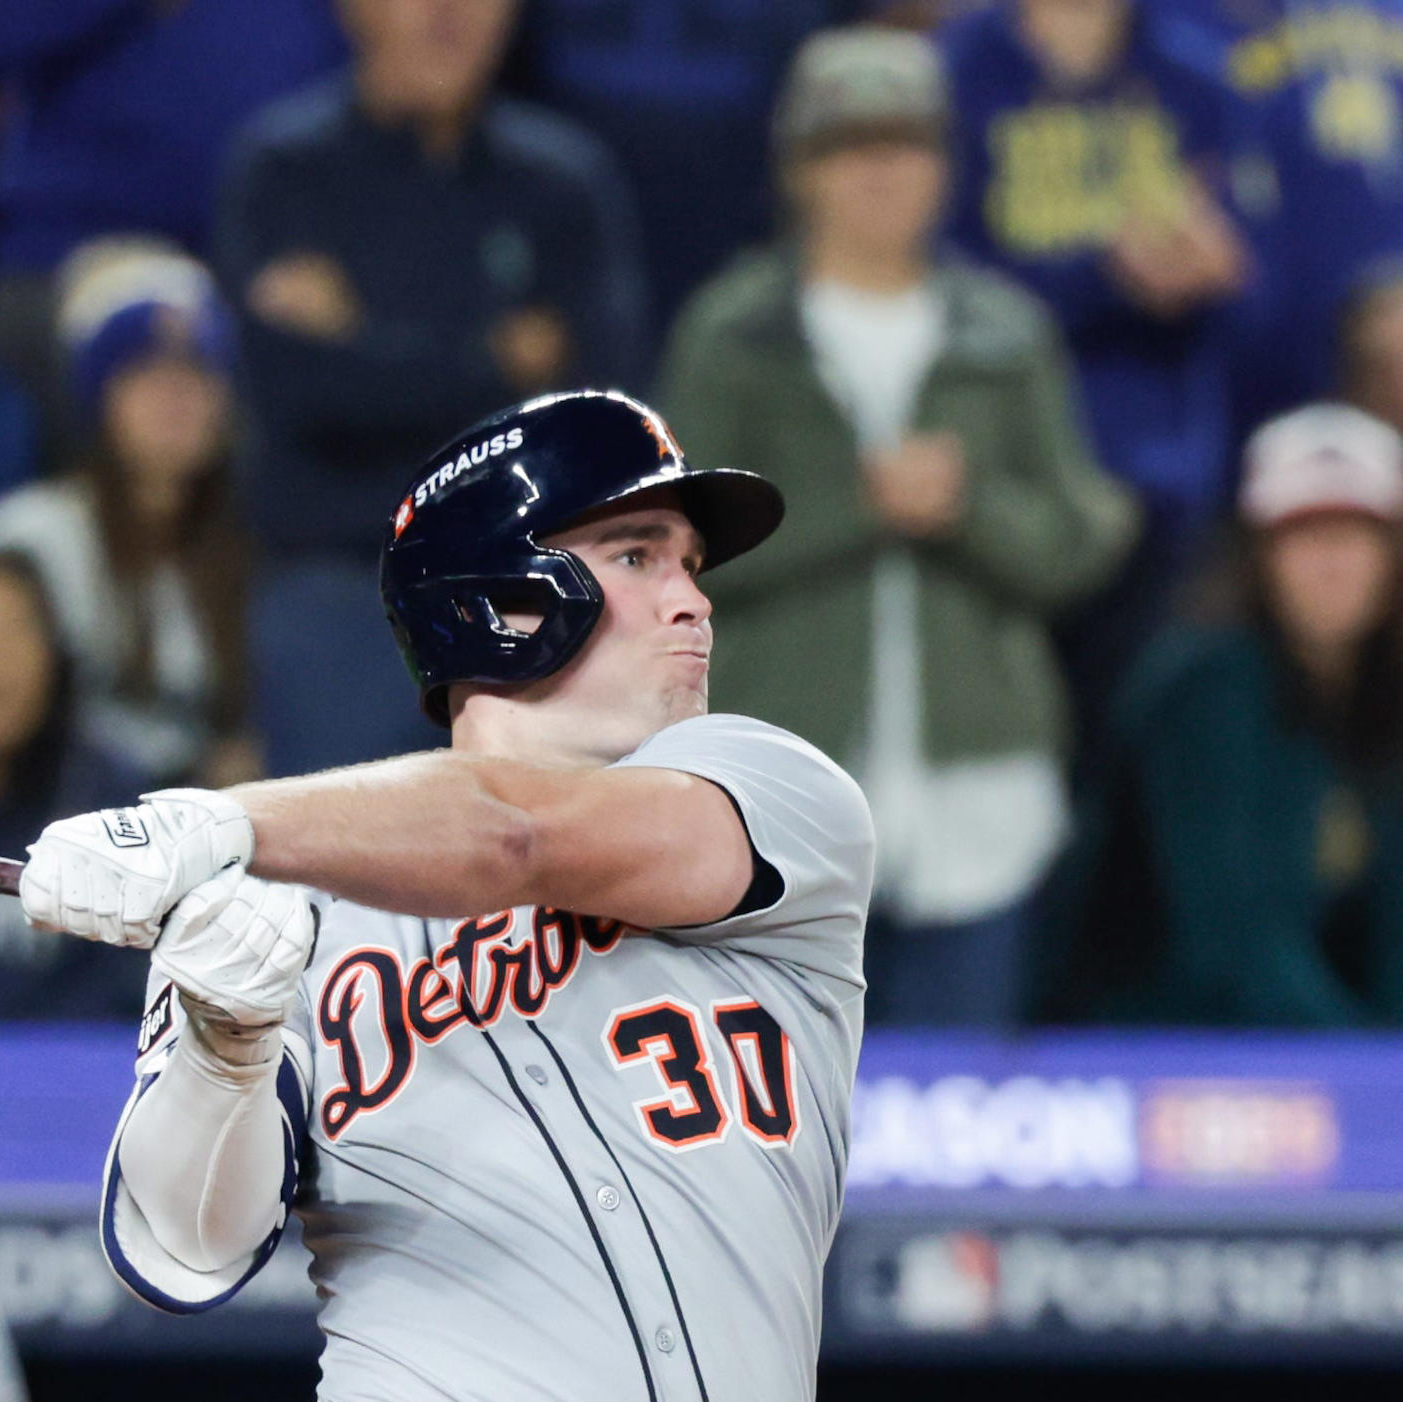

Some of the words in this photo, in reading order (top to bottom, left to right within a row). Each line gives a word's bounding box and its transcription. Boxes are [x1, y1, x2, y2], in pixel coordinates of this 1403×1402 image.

[414, 427, 524, 508] STRAUSS
[317, 905, 633, 1143] Detro
[602, 994, 799, 1153] 30
